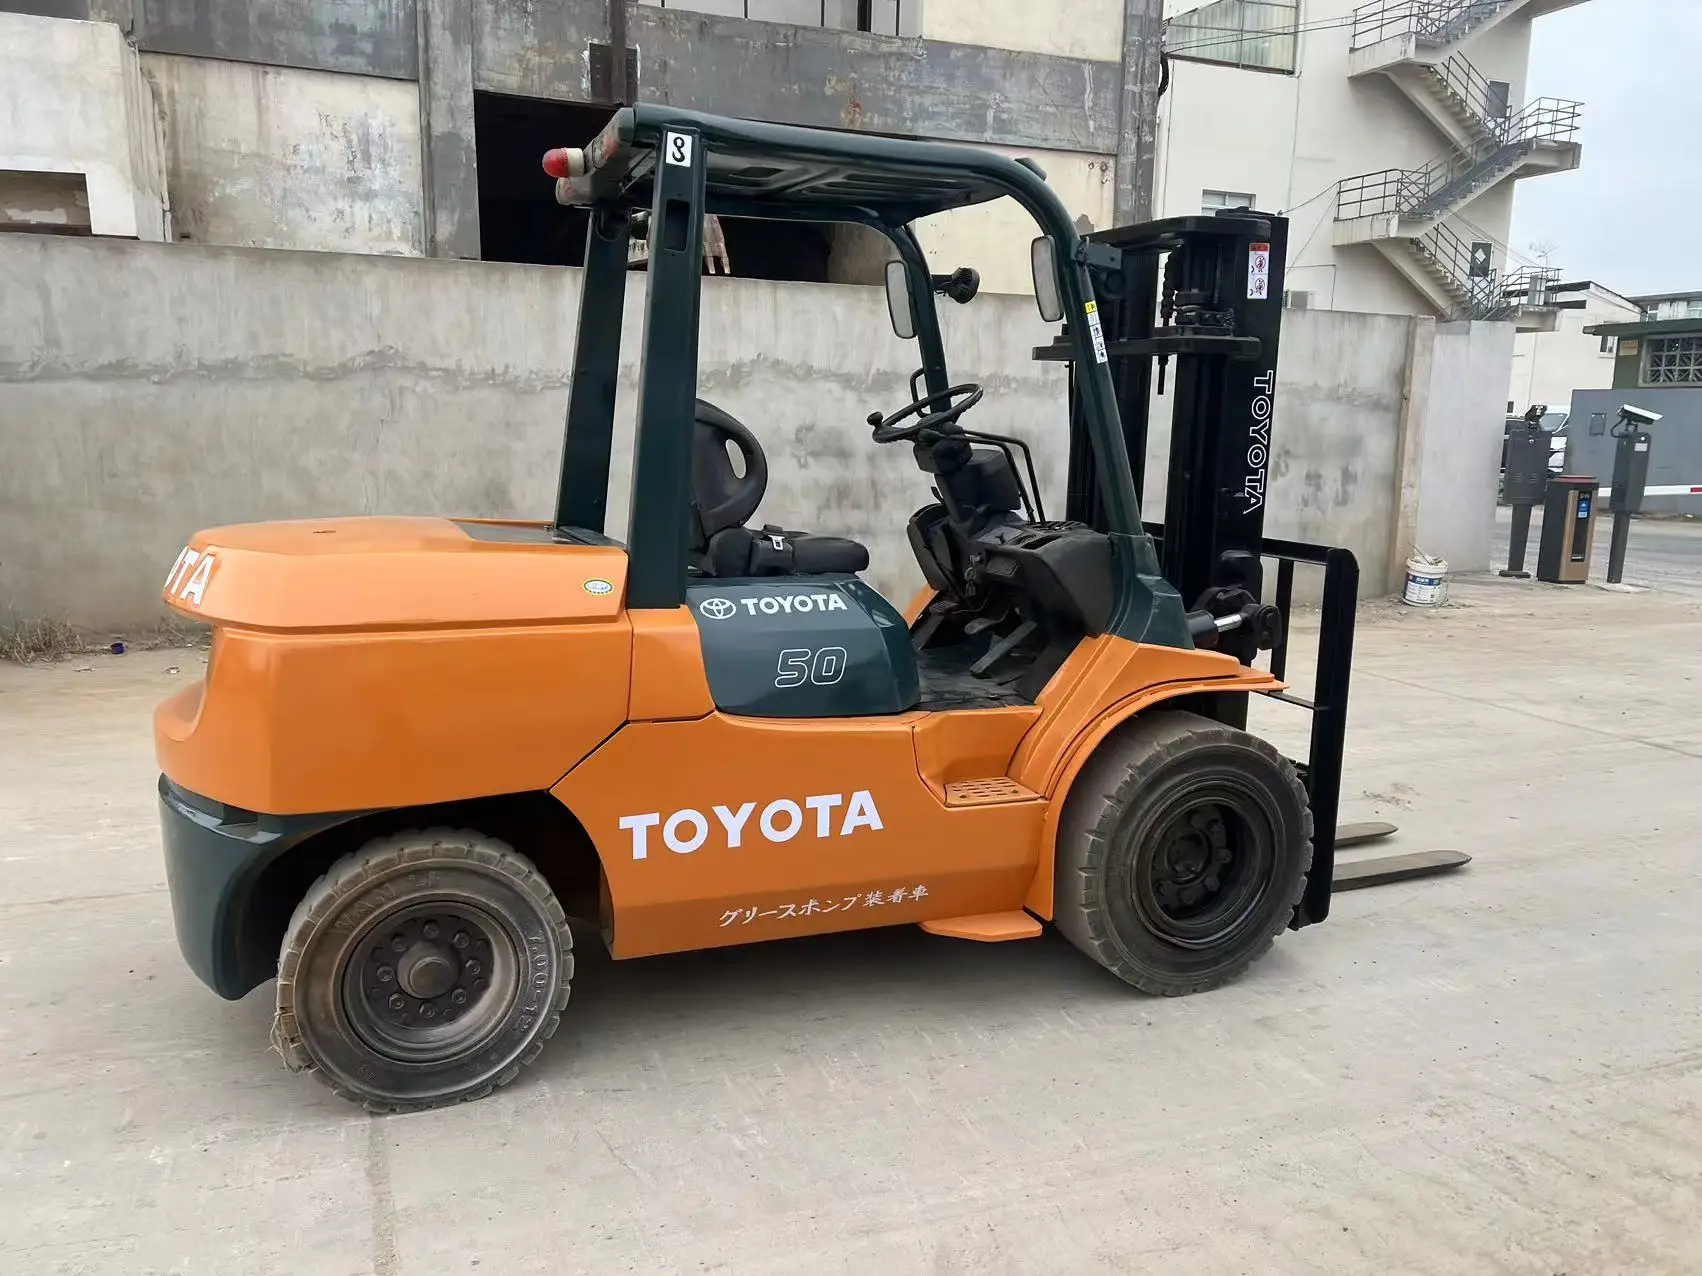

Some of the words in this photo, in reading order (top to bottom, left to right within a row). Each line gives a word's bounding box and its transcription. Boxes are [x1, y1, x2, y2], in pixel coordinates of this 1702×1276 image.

[1243, 370, 1274, 514] TOYOTA
[740, 593, 848, 616] TOYOTA
[775, 646, 848, 688] 50
[619, 789, 884, 860] TOYOTA
